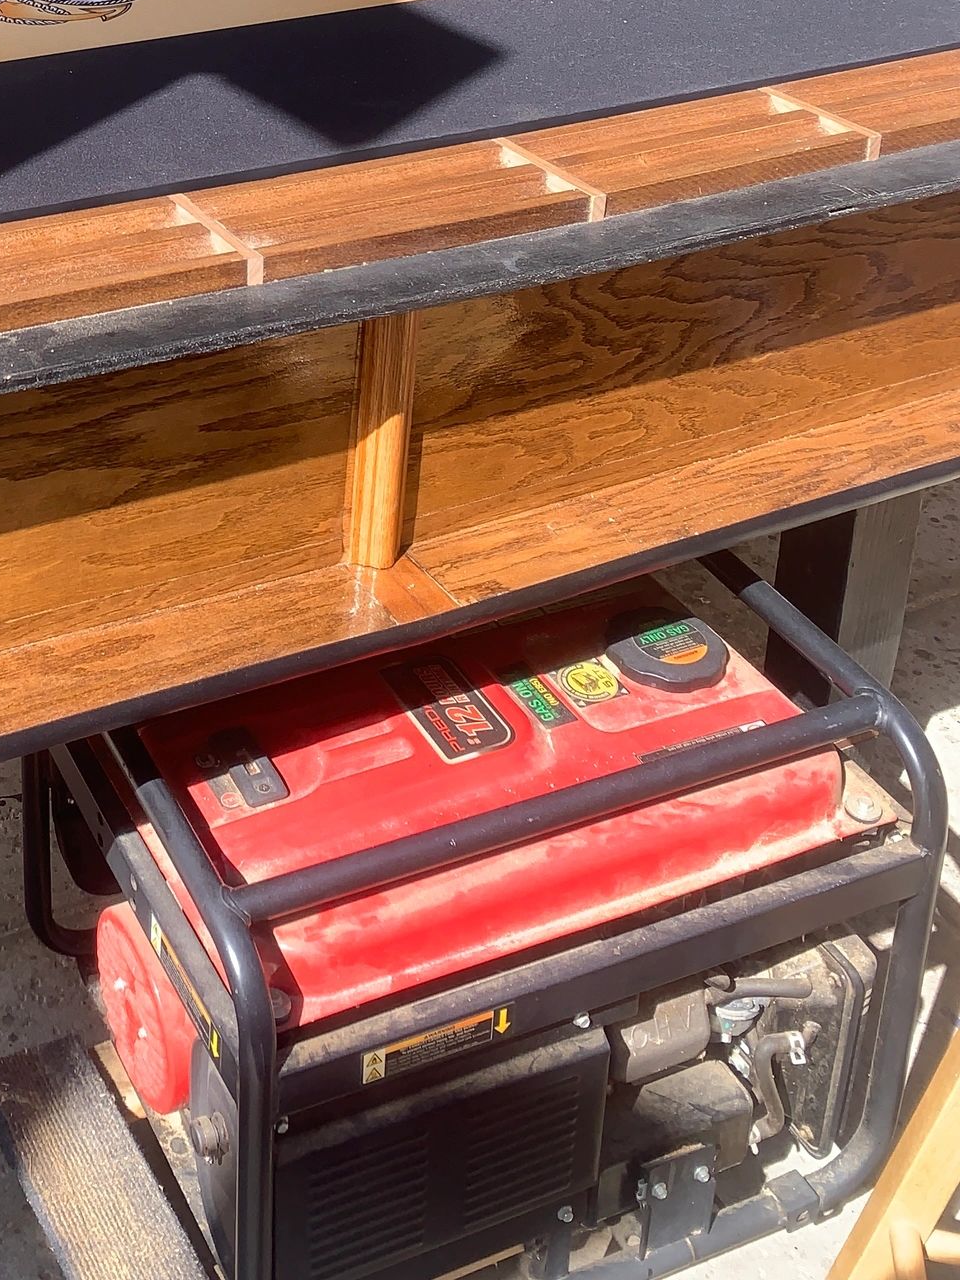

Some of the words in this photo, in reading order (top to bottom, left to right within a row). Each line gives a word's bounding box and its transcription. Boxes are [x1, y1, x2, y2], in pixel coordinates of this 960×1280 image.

[639, 630, 667, 645] ONLY
[666, 624, 690, 637] GAS
[528, 677, 547, 694] E85)
[544, 691, 560, 706] (NO
[529, 698, 556, 722] GAS
[445, 704, 494, 737] 12
